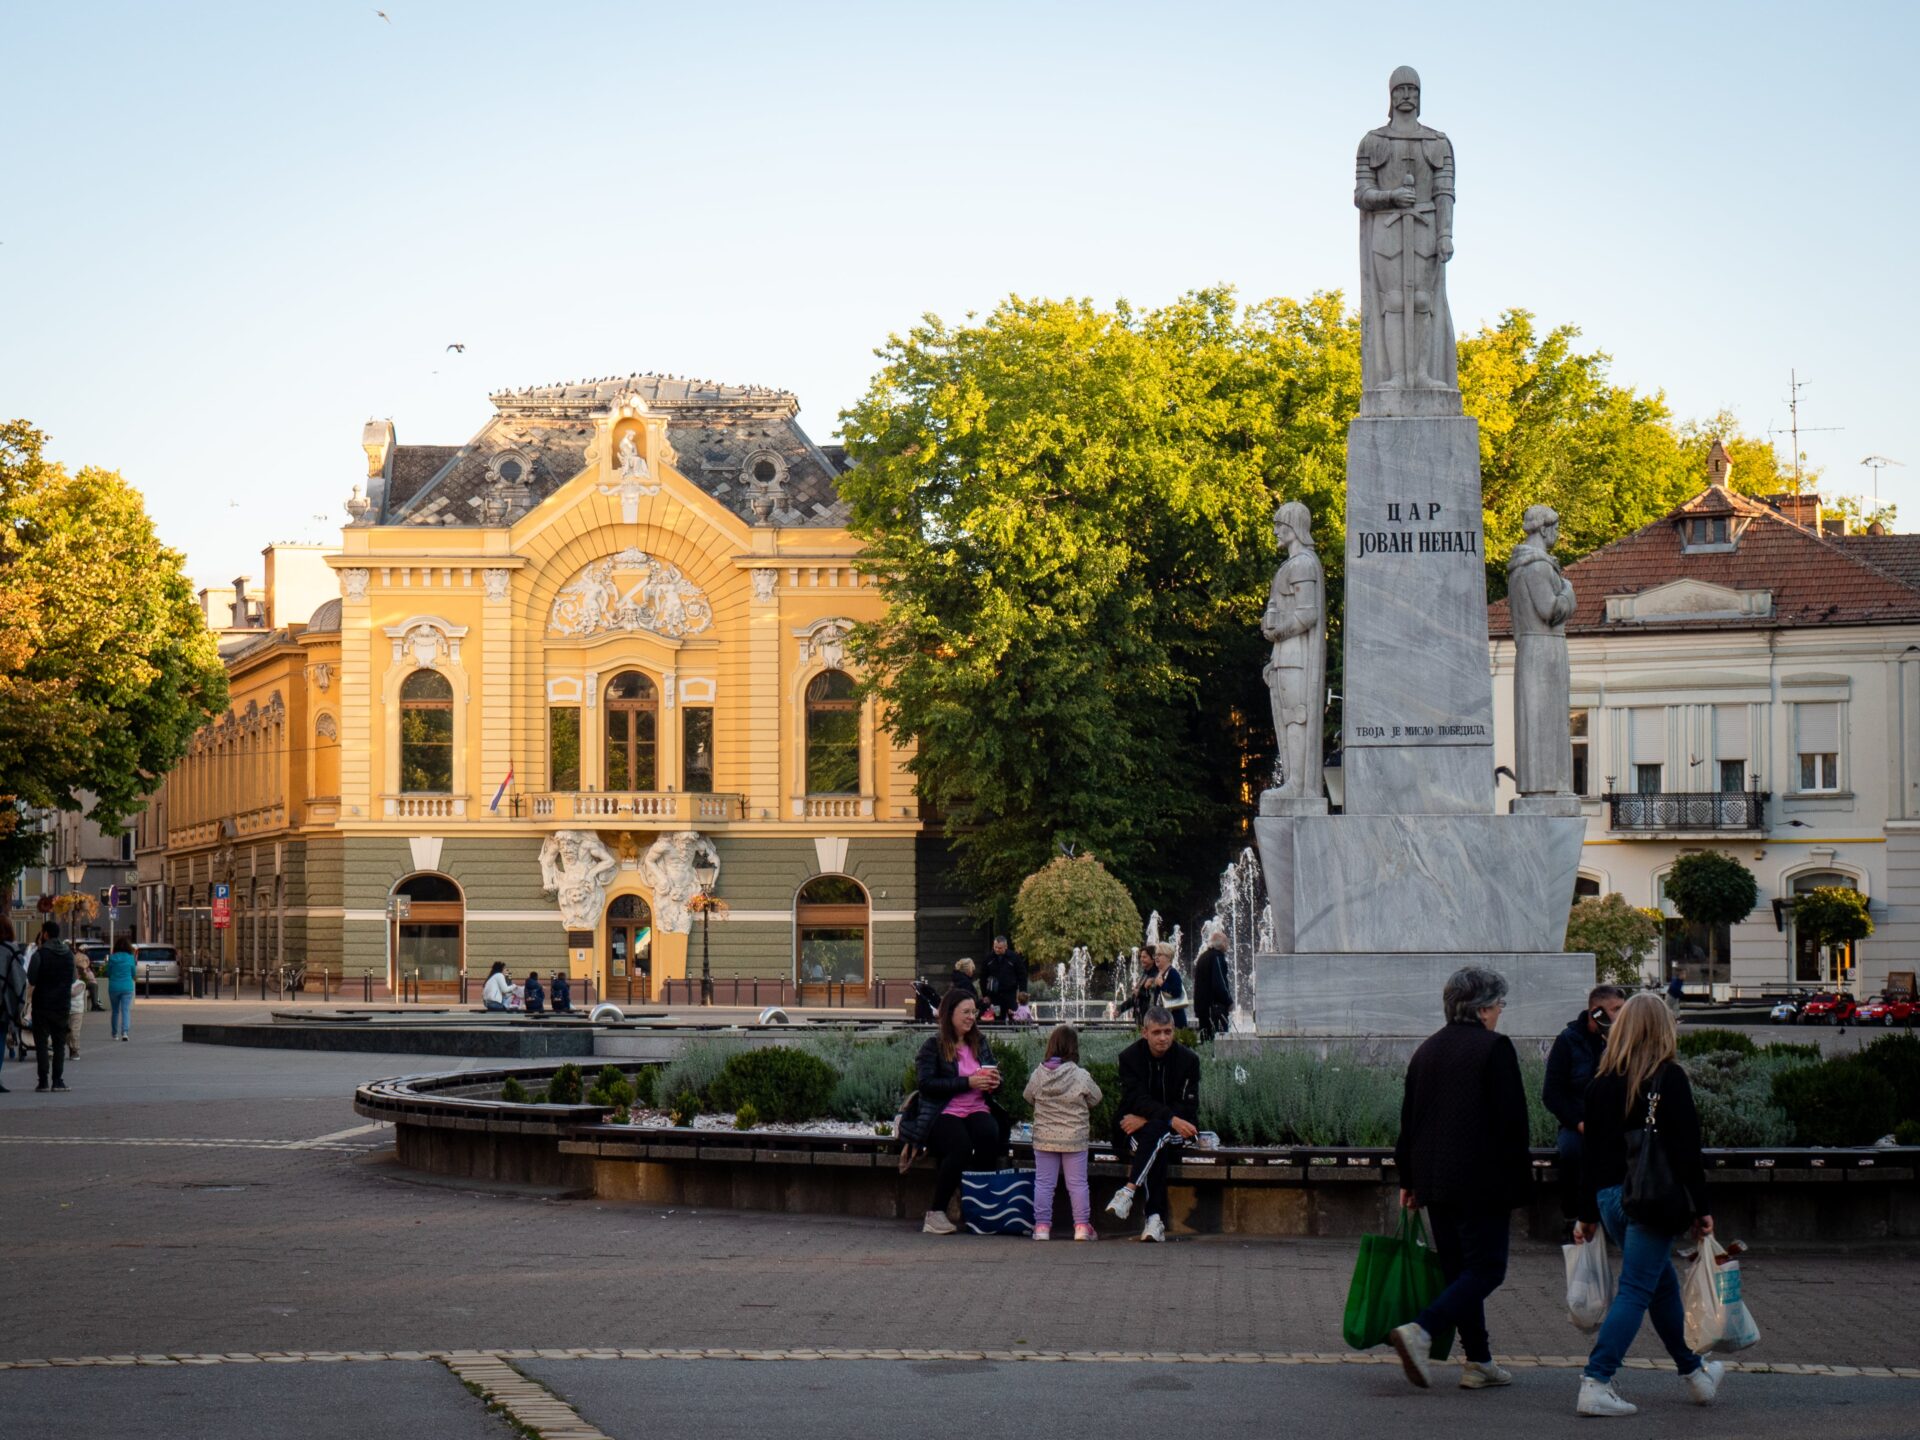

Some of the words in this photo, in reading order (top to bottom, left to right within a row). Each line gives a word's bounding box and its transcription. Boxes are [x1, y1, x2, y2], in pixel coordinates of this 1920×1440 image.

[1387, 503, 1441, 523] ЦАР
[1357, 532, 1413, 558] ЈОВАН
[1419, 532, 1477, 557] НЕНАД
[1355, 726, 1386, 739] ТВОЈА
[1390, 726, 1401, 739] ЈЕ
[1404, 726, 1434, 736] МИСАО
[1438, 725, 1485, 737] ПОБЕДИЛА
[218, 886, 226, 898] P
